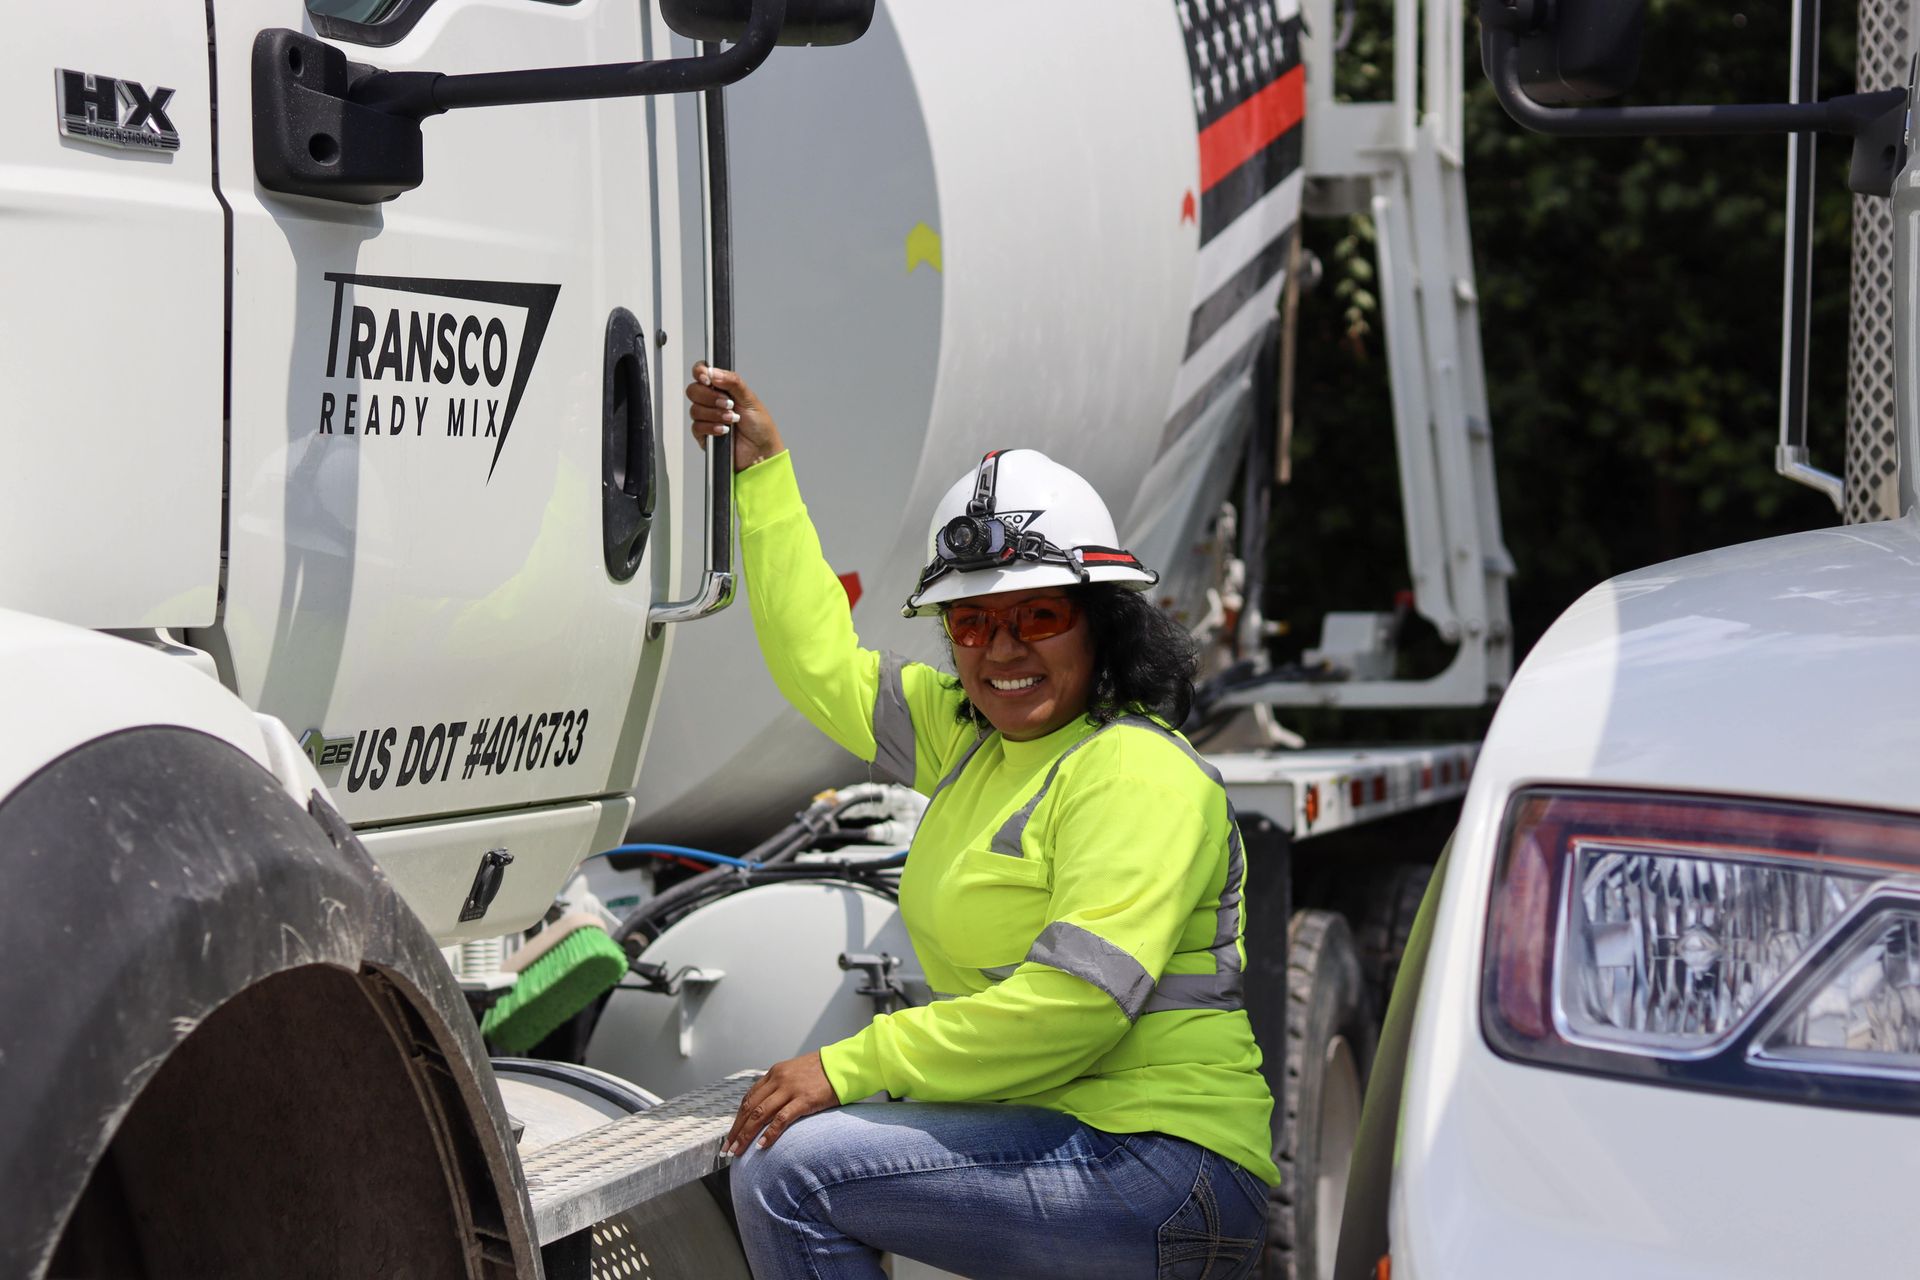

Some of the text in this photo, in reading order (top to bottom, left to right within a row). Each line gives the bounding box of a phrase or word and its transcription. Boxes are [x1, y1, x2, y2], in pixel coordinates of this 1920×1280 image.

[62, 68, 178, 134] HX
[86, 126, 158, 147] INTERNATIONAL
[324, 272, 508, 388] TRANSCO
[319, 392, 499, 438] READY MIX
[347, 708, 589, 793] US DOT #4016733
